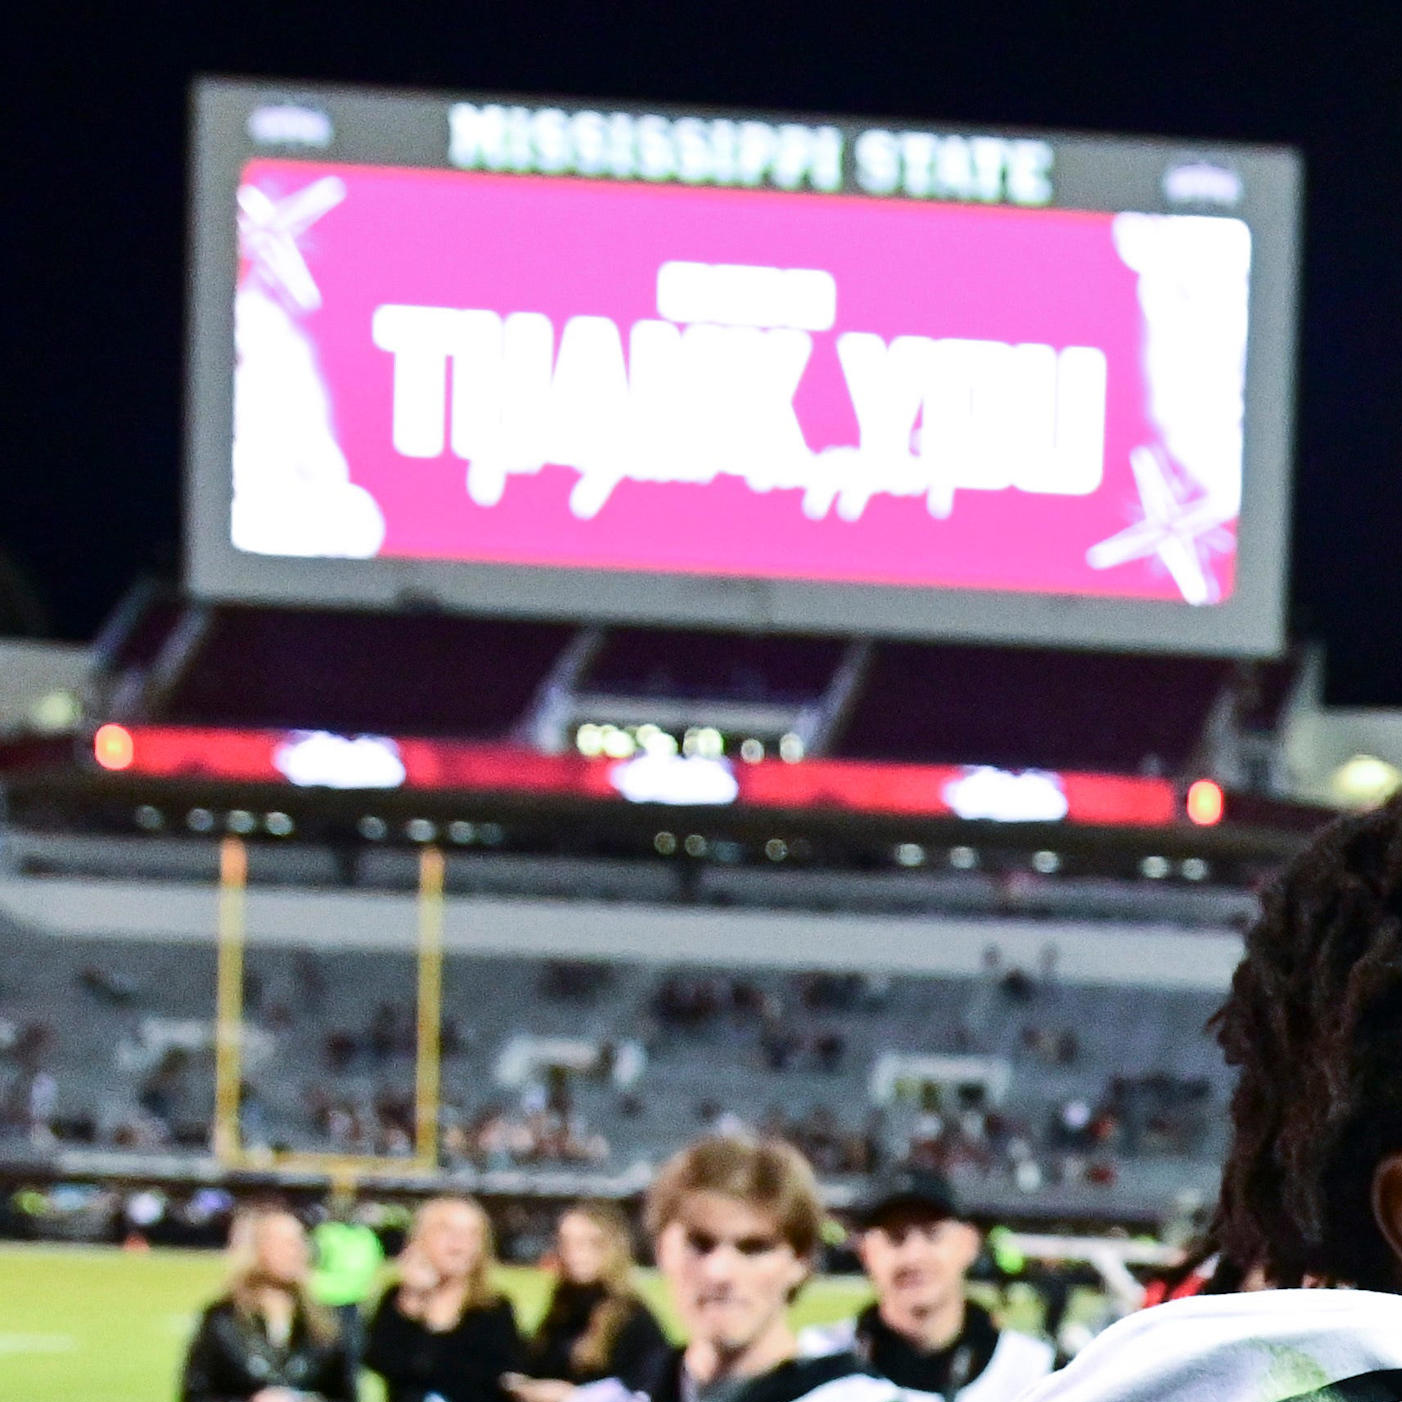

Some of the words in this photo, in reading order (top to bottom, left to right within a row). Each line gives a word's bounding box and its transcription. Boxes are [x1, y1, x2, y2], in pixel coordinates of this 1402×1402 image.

[448, 103, 843, 193] MISSISSIPPI
[854, 128, 1054, 206] STATE
[371, 302, 815, 498] THANK
[835, 330, 1109, 498] YOU
